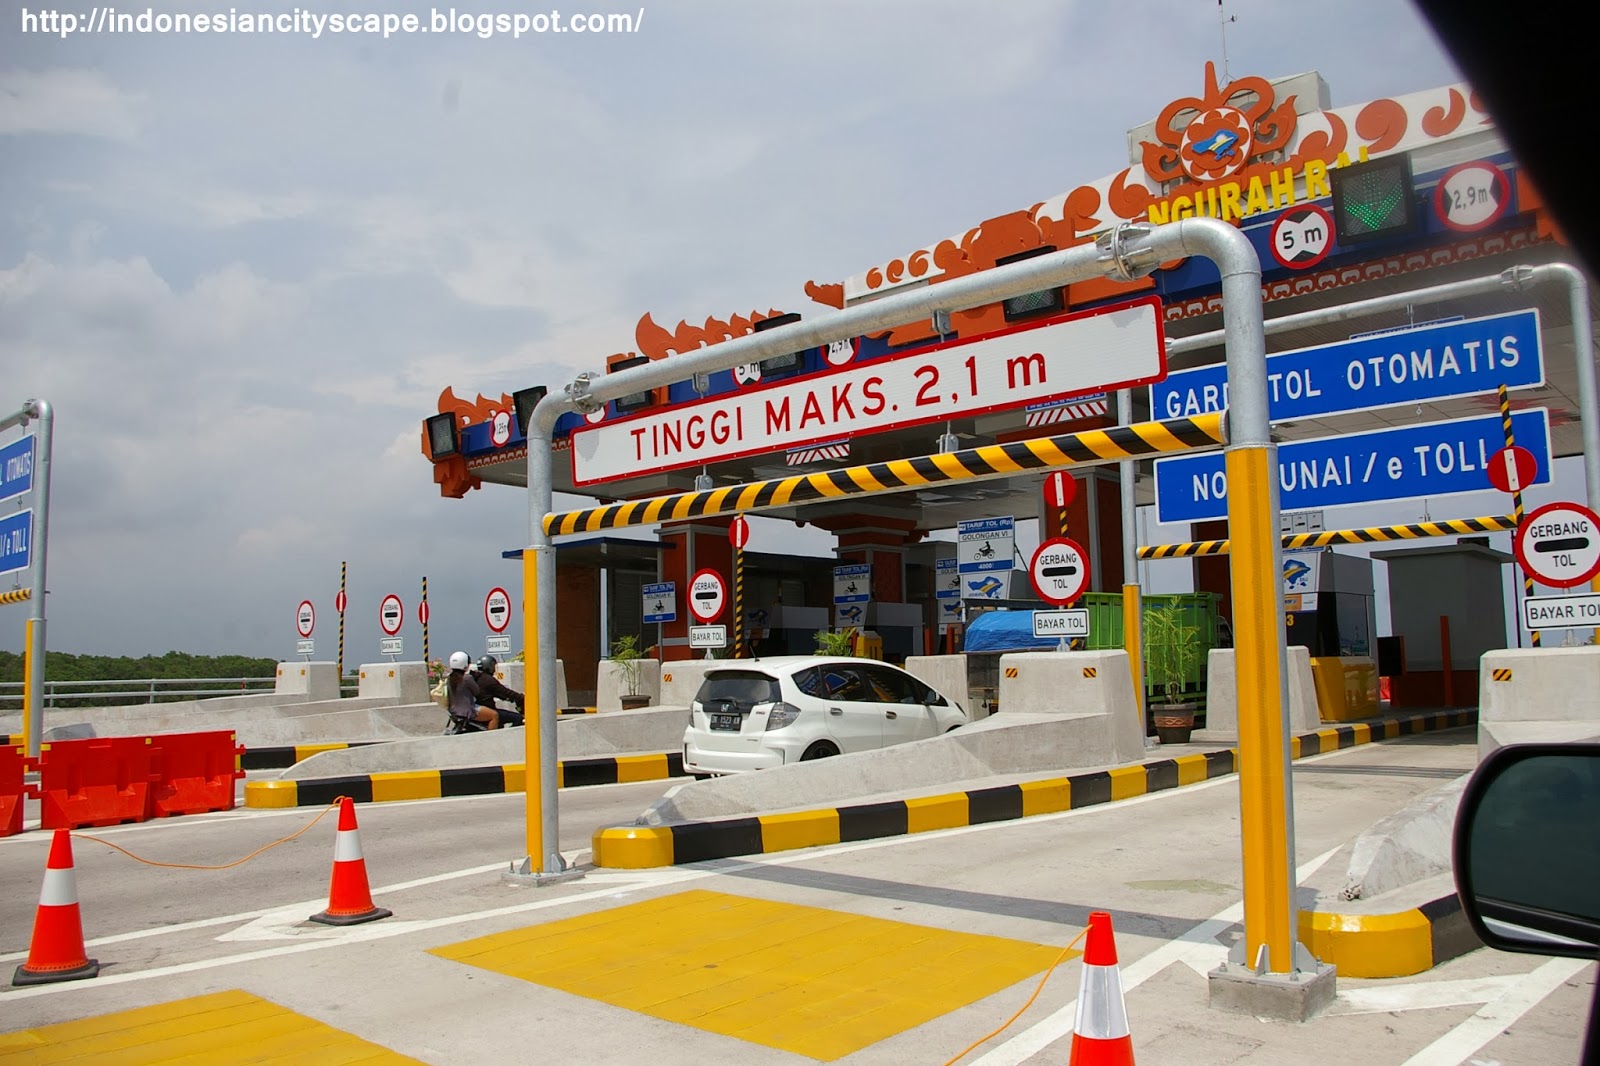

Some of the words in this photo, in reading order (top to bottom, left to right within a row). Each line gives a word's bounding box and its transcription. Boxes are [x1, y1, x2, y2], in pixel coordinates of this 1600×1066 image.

[1148, 166, 1296, 225] NGURAH
[1282, 231, 1294, 249] 5
[1268, 369, 1322, 402] TOL
[1346, 335, 1520, 391] OTOMATIS
[630, 406, 743, 461] TINGGI
[765, 376, 898, 436] MAKS.
[913, 355, 978, 407] 2,1
[1006, 352, 1047, 389] m
[1280, 455, 1352, 492] UNAI
[962, 531, 1000, 541] GOLONGAN
[1530, 520, 1588, 538] GERBANG
[1039, 553, 1077, 566] GERBANG
[1552, 554, 1576, 568] TOL
[694, 582, 718, 591] GERBANG
[1053, 579, 1068, 589] TOL
[702, 602, 712, 610] TOL
[1529, 605, 1575, 620] BAYAR
[1037, 618, 1065, 629] BAYAR
[1068, 617, 1084, 628] TOL
[692, 633, 711, 642] BAYAR
[712, 632, 723, 641] TOL
